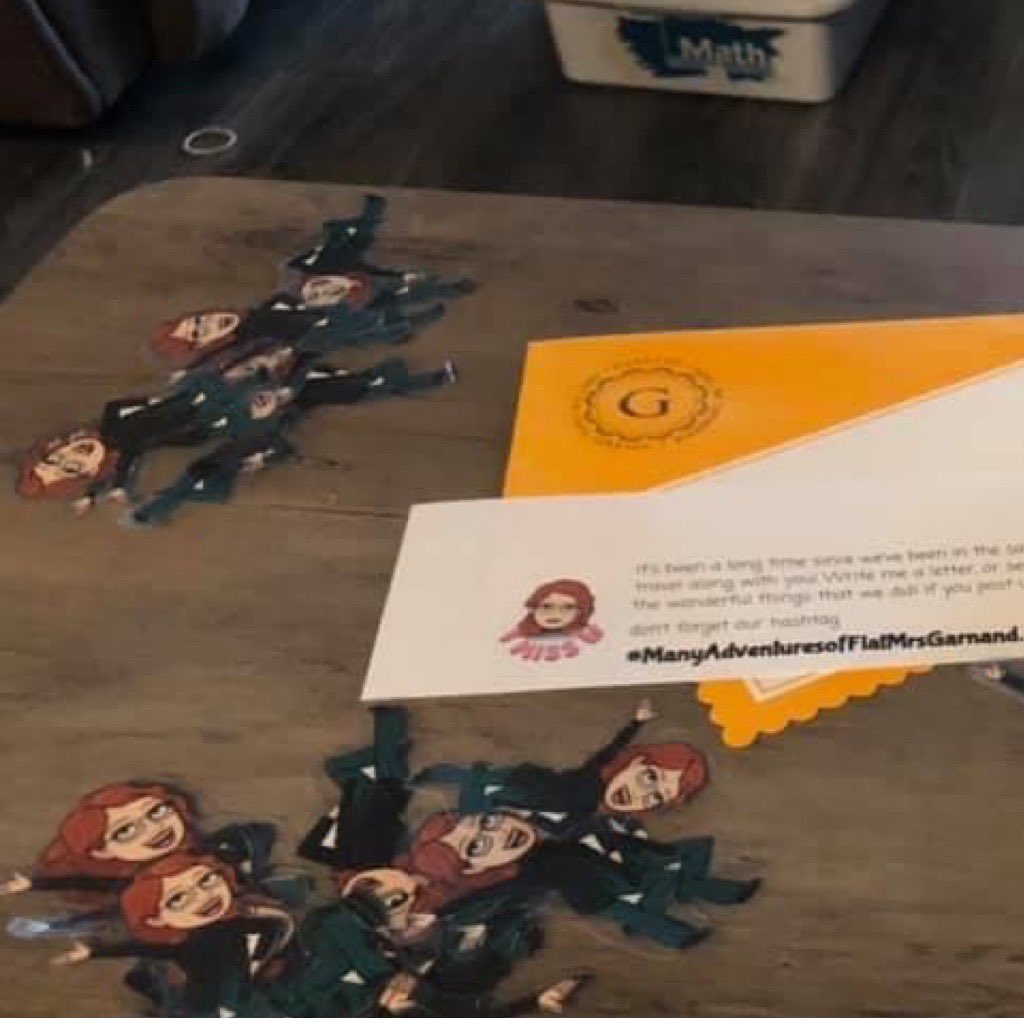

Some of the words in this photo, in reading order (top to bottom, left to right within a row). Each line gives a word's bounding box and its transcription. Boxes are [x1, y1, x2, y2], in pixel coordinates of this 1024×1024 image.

[680, 37, 767, 69] Math
[620, 387, 670, 418] G
[665, 561, 705, 573] been
[711, 561, 721, 573] a
[727, 558, 763, 573] long
[768, 556, 807, 568] time
[813, 554, 853, 567] since
[907, 547, 948, 560] been
[952, 546, 969, 558] in
[973, 543, 1000, 556] the
[635, 579, 683, 592] travel
[687, 577, 735, 593] along
[740, 574, 778, 587] with
[821, 569, 875, 583] Write
[880, 568, 907, 580] me
[912, 567, 925, 578] a
[981, 562, 999, 574] or
[633, 597, 660, 610] the
[665, 591, 753, 609] wonderful
[758, 591, 812, 608] things
[817, 588, 853, 602] that
[858, 588, 884, 599] we
[942, 582, 972, 599] you
[976, 578, 1013, 595] post
[675, 619, 729, 637] forget
[735, 618, 764, 631] our
